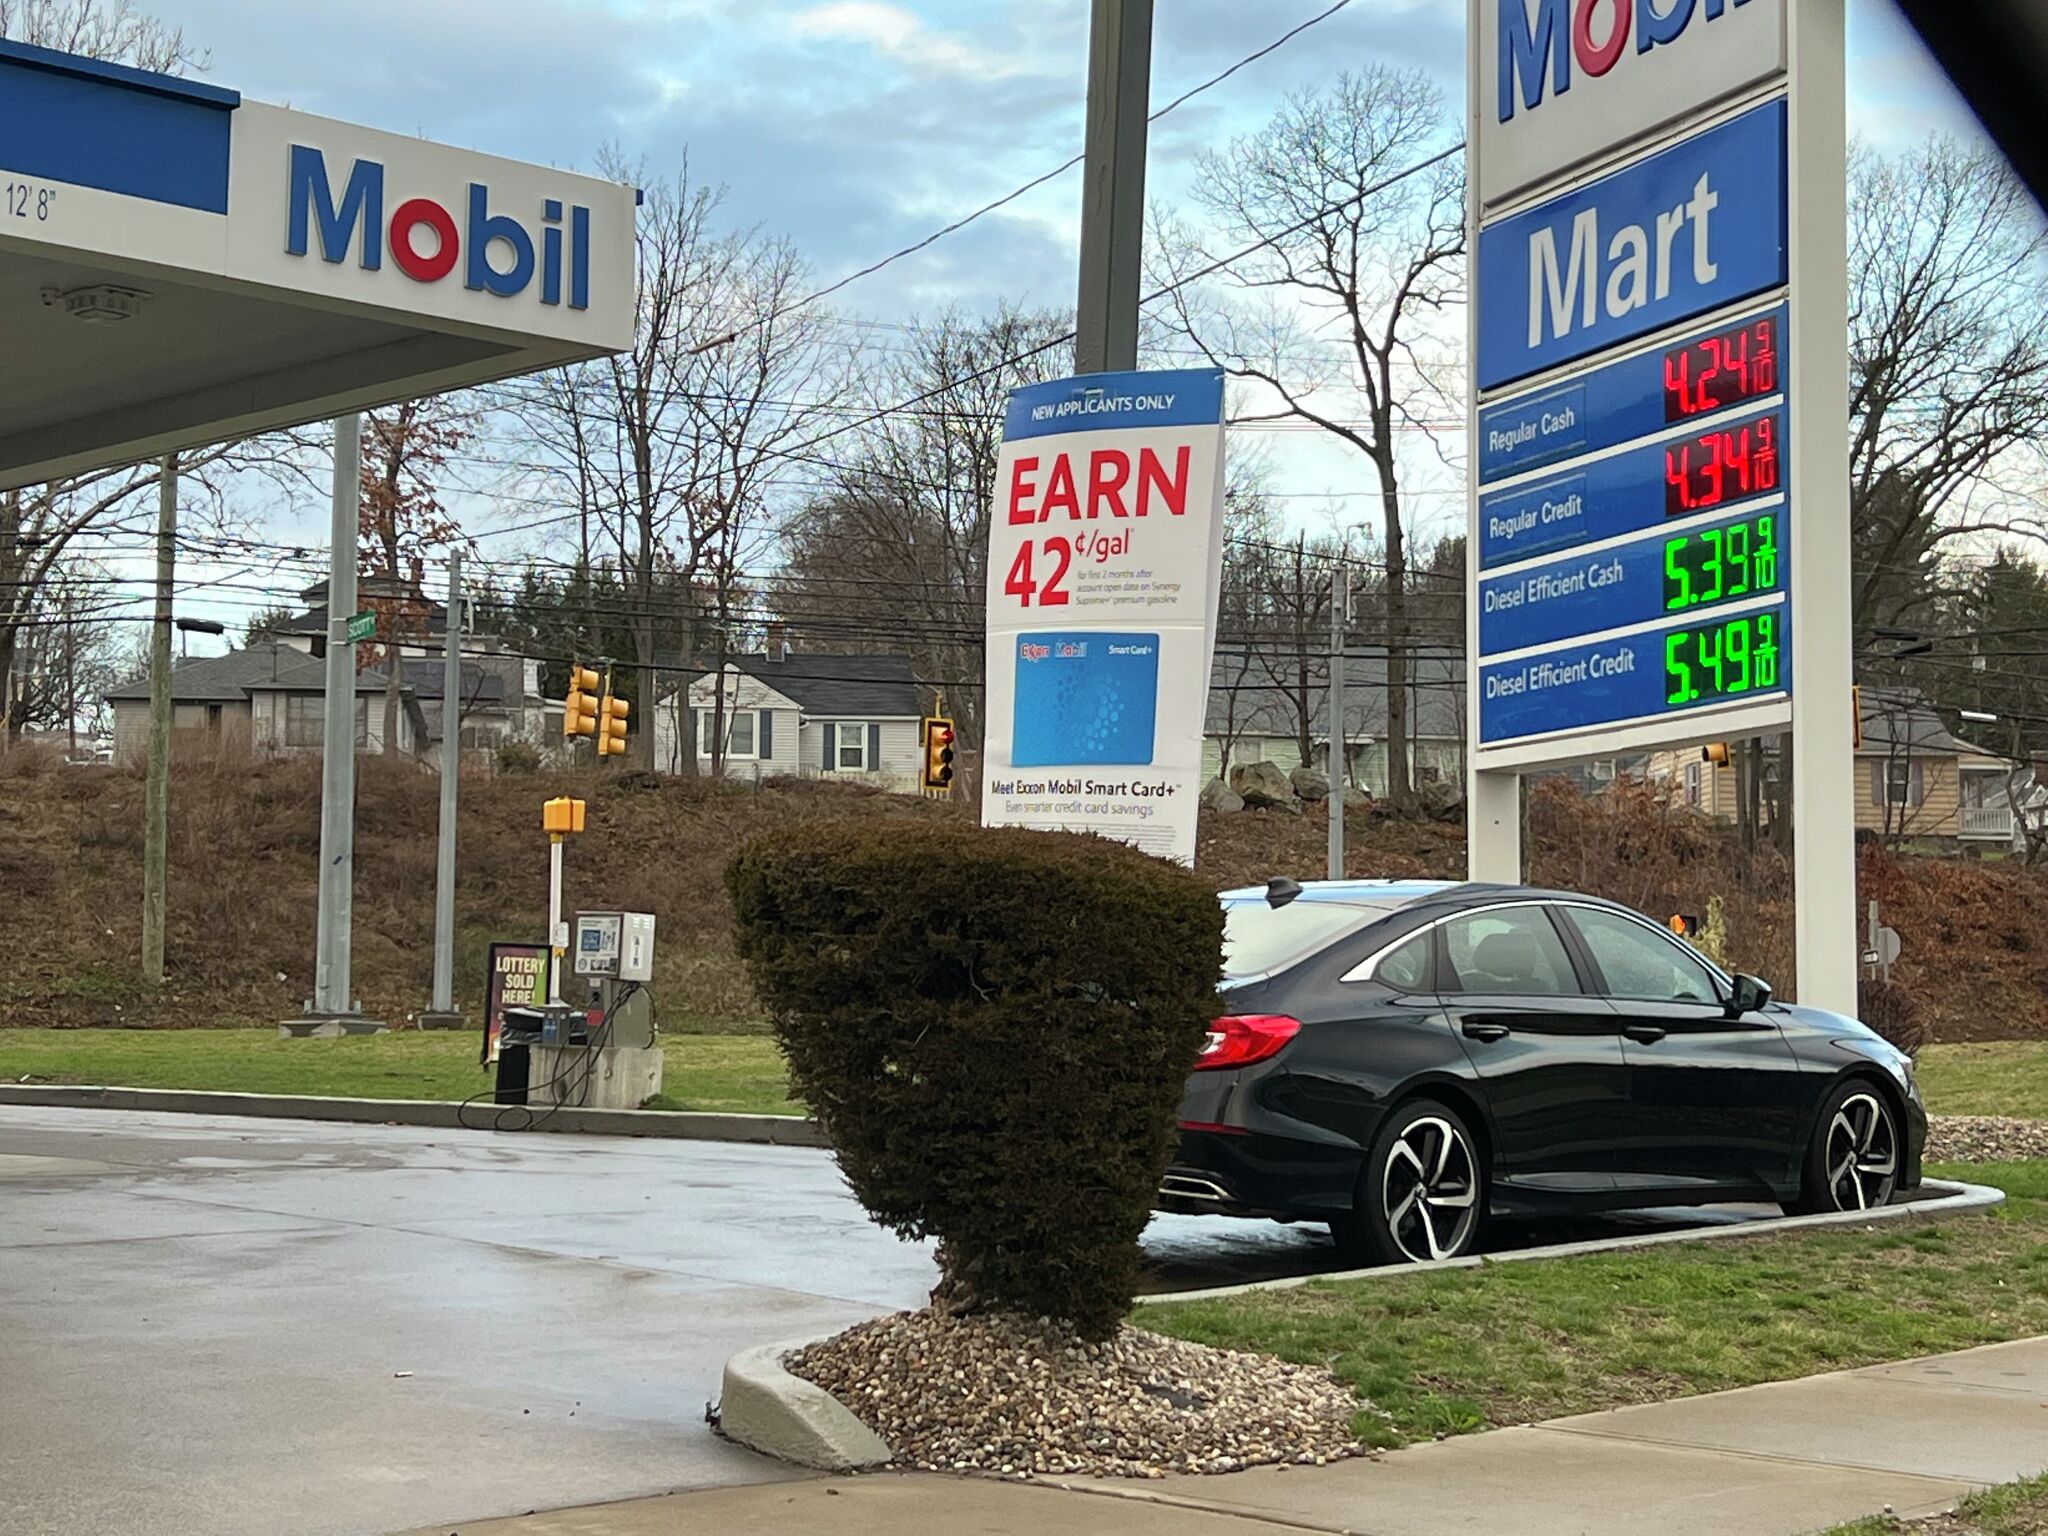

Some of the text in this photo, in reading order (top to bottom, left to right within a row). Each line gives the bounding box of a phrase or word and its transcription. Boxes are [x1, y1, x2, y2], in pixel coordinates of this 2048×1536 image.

[6, 182, 33, 217] 12'
[286, 144, 590, 309] Mobil
[1527, 172, 1719, 349] Mart
[1032, 394, 1176, 421] NEW APPLICANTS ONLY
[1489, 421, 1537, 451] Regular
[1541, 406, 1575, 435] Cash
[1008, 446, 1191, 526] EARN
[1489, 508, 1538, 540] Regular
[1541, 494, 1583, 524] Credit
[1102, 569, 1107, 579] 2
[1108, 570, 1134, 579] months
[1136, 568, 1153, 579] after
[1485, 581, 1525, 613] Diesel
[1527, 571, 1585, 603] Efficient
[1588, 558, 1624, 589] Cash
[1666, 523, 1749, 609] 5.39
[1077, 584, 1102, 593] account
[1104, 584, 1121, 595] open
[1140, 584, 1151, 592] on
[1152, 581, 1181, 593] Synergy
[1147, 594, 1178, 607] gasoline
[1108, 644, 1130, 655] Smart
[1486, 669, 1527, 700] Diesel
[1529, 659, 1587, 691] Efficient
[1590, 648, 1635, 678] Credit
[1666, 619, 1749, 704] 5.49
[991, 780, 1014, 795] Meet
[1016, 780, 1046, 795] Exxon
[1048, 778, 1082, 795] Mobil
[1085, 779, 1127, 796] Smart
[1005, 800, 1154, 819] Even smarter credit card savings
[495, 956, 546, 974] LOTTERY
[505, 974, 535, 989] SOLD
[502, 989, 536, 1005] HERE!
